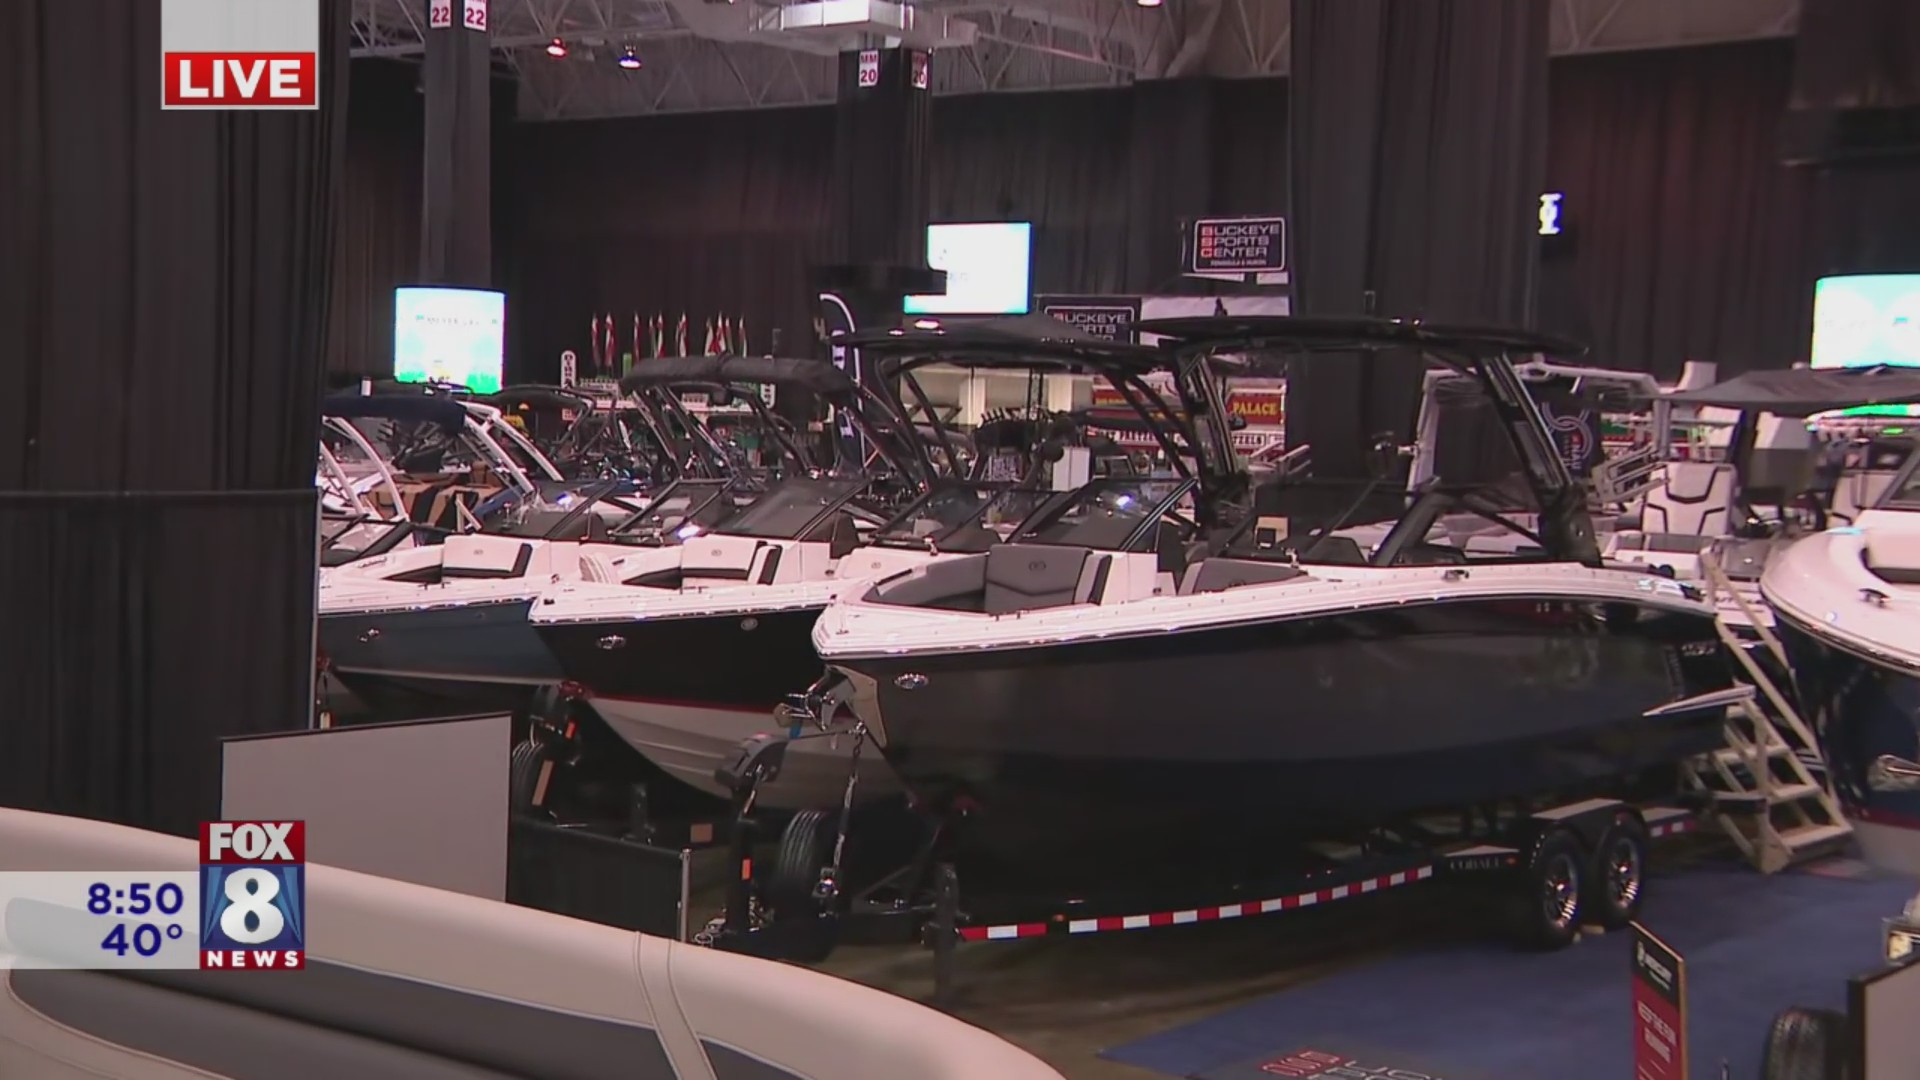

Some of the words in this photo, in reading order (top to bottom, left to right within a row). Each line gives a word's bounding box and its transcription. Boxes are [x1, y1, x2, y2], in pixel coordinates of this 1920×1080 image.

[432, 6, 449, 24] 22
[466, 7, 485, 26] 22
[860, 69, 877, 83] 20
[1201, 224, 1280, 236] BUCKEYE
[1201, 235, 1269, 247] SPORTS
[1201, 247, 1267, 258] CENTER
[1232, 402, 1278, 416] PALACE
